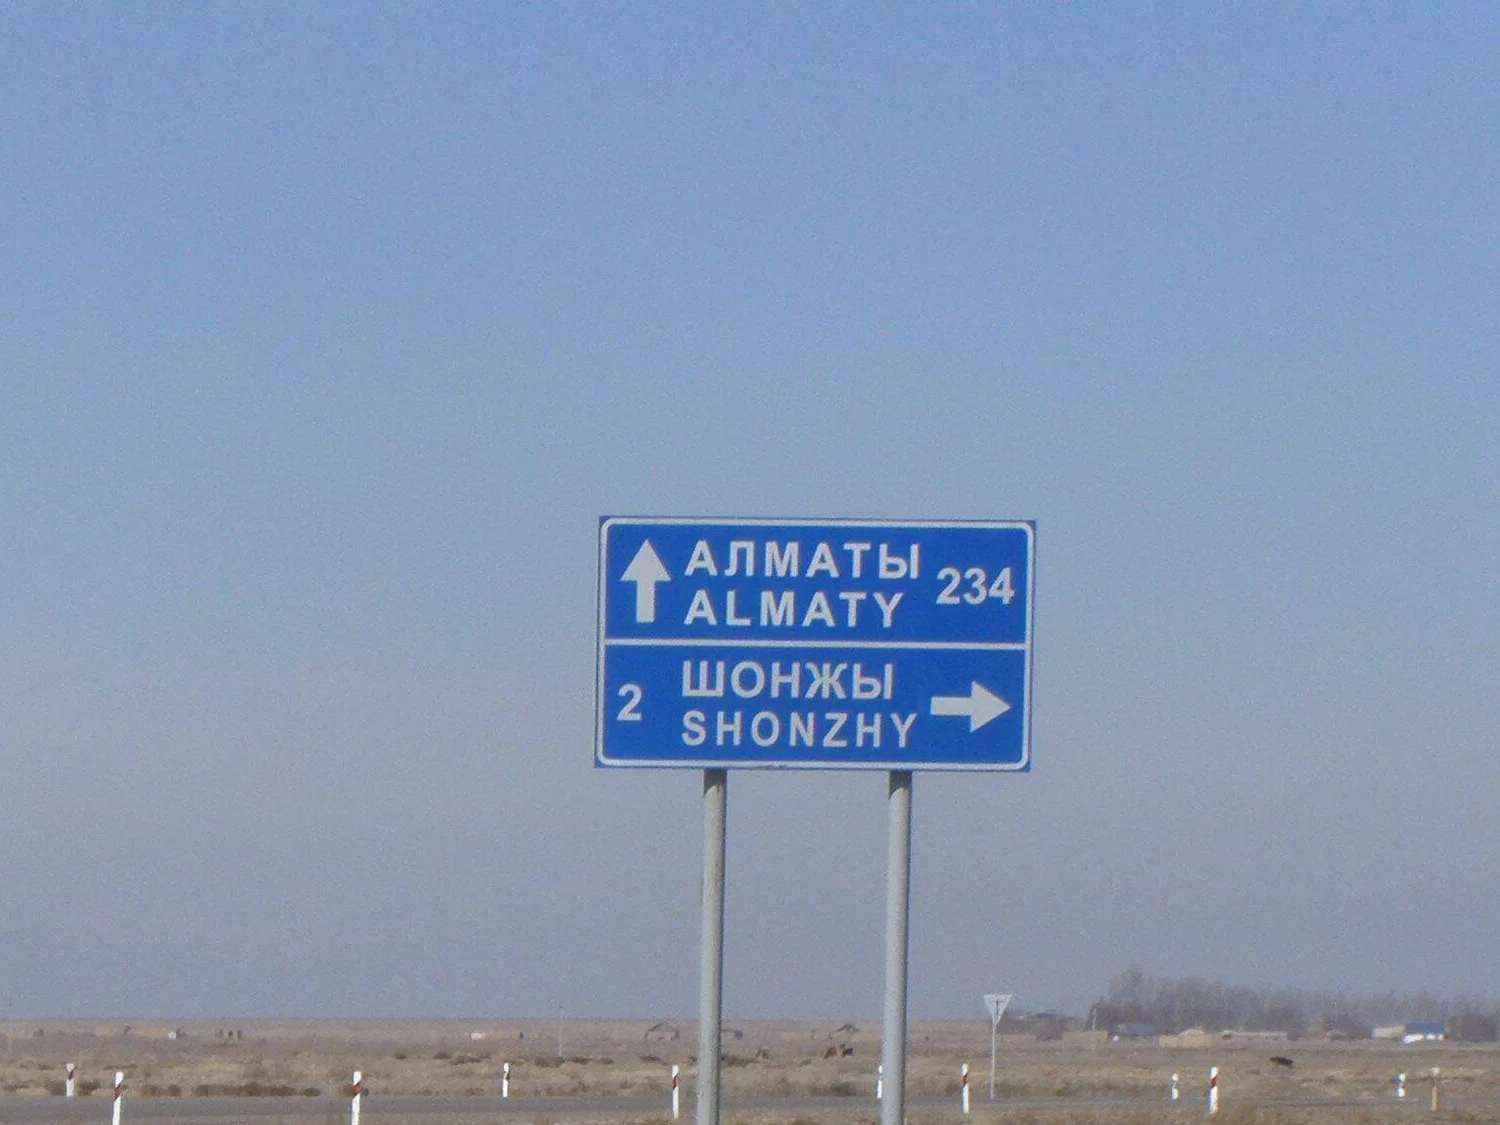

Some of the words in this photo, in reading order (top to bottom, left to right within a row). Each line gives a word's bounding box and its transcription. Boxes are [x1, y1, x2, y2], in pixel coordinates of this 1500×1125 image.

[684, 540, 920, 579] АЛМАТЫ
[936, 567, 1015, 605] 234
[684, 589, 904, 628] ALMATY
[682, 660, 893, 700] ШОНЖЫ
[617, 683, 642, 721] 2
[682, 709, 917, 747] SHONZHY
